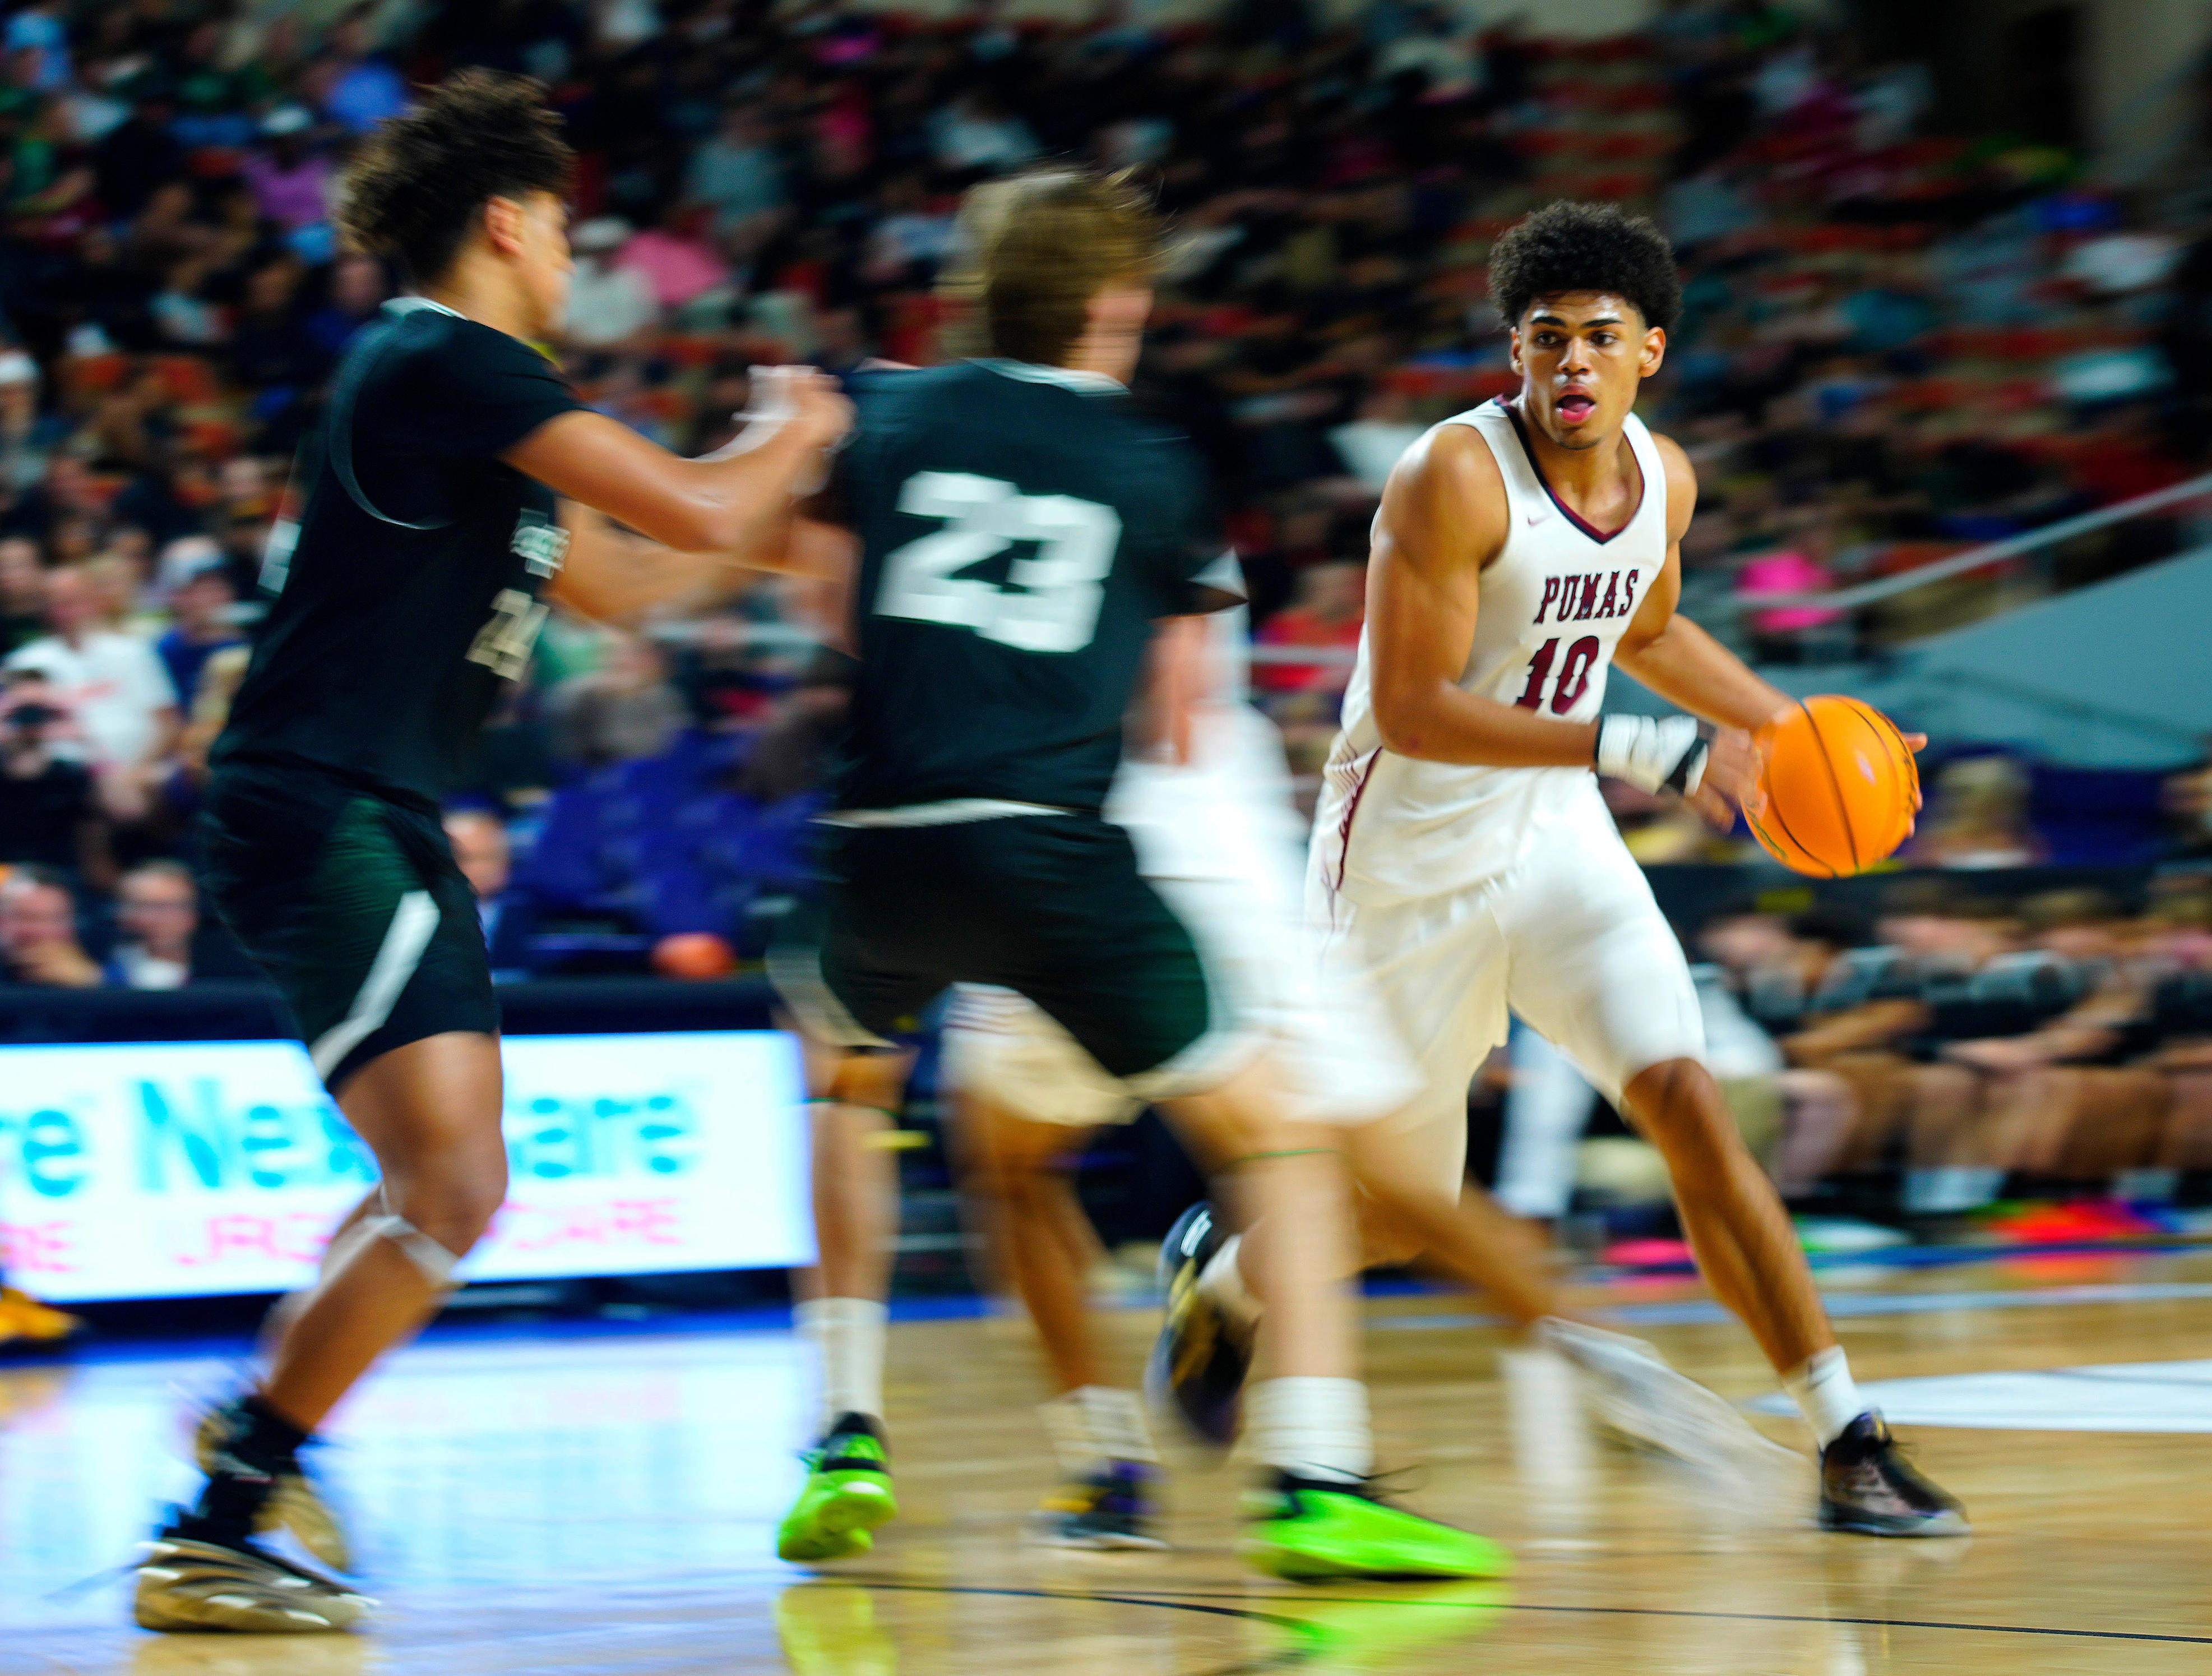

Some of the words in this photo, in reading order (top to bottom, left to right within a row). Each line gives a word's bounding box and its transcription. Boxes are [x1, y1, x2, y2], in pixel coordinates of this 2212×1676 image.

[873, 471, 1124, 653] 23
[1533, 569, 1640, 625] PUMAS
[1514, 635, 1600, 714] 10
